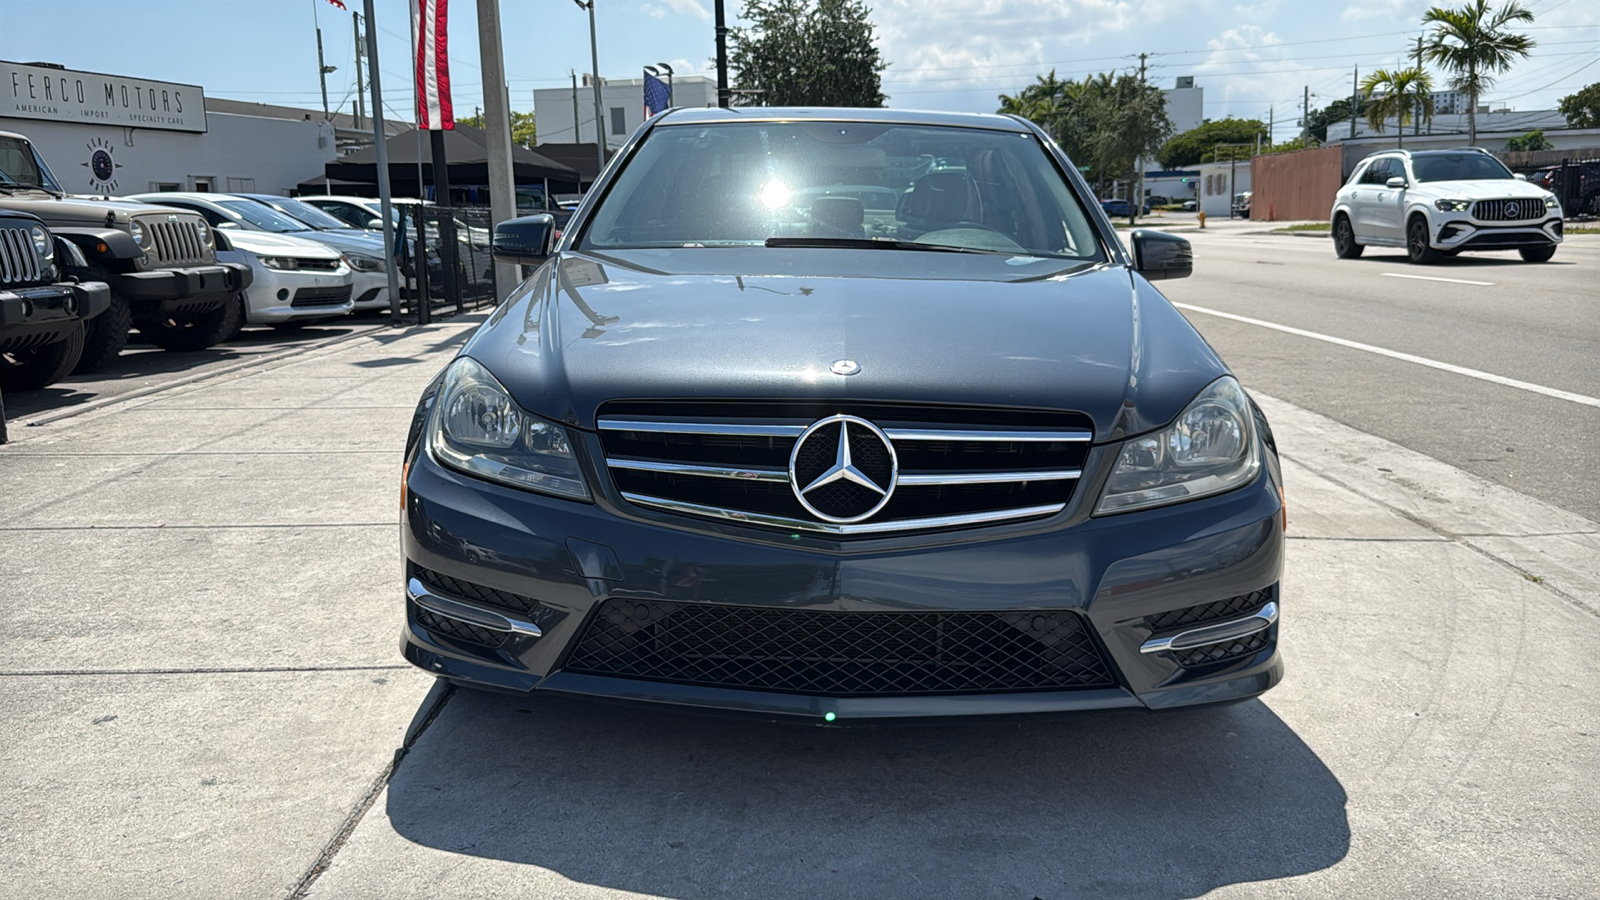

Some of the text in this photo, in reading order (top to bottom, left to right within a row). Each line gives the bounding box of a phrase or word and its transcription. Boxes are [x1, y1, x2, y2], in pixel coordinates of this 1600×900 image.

[12, 72, 183, 114] FERCO MOTORS
[15, 104, 59, 115] AMERICAN
[80, 110, 109, 119] IMPORT
[129, 114, 165, 124] SPECIALTY
[167, 117, 184, 126] CARS
